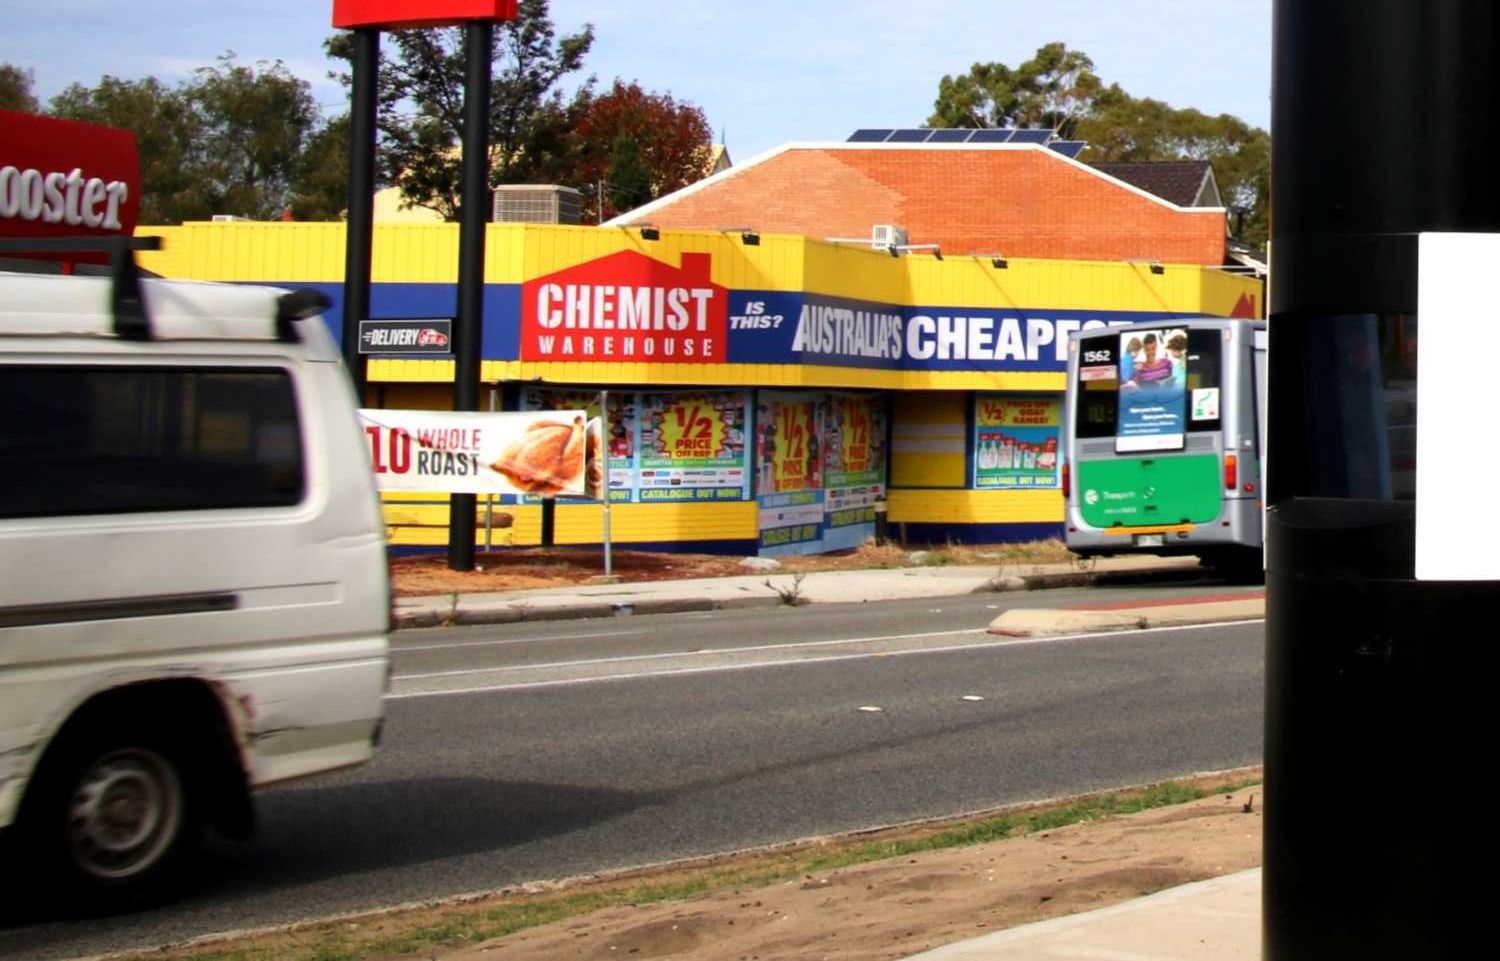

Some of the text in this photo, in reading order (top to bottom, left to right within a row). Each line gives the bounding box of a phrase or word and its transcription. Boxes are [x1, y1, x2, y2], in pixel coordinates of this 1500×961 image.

[537, 284, 714, 332] CHEMIST
[745, 301, 766, 315] IS
[730, 315, 784, 329] THIS?
[792, 304, 902, 360] AUSTRALIA'S
[370, 328, 420, 346] DELIVERY
[538, 335, 713, 357] WAREHOUSE
[1084, 349, 1112, 363] 1562
[417, 428, 481, 450] WHOLE
[675, 439, 712, 450] PRICE
[417, 450, 480, 475] ROAST
